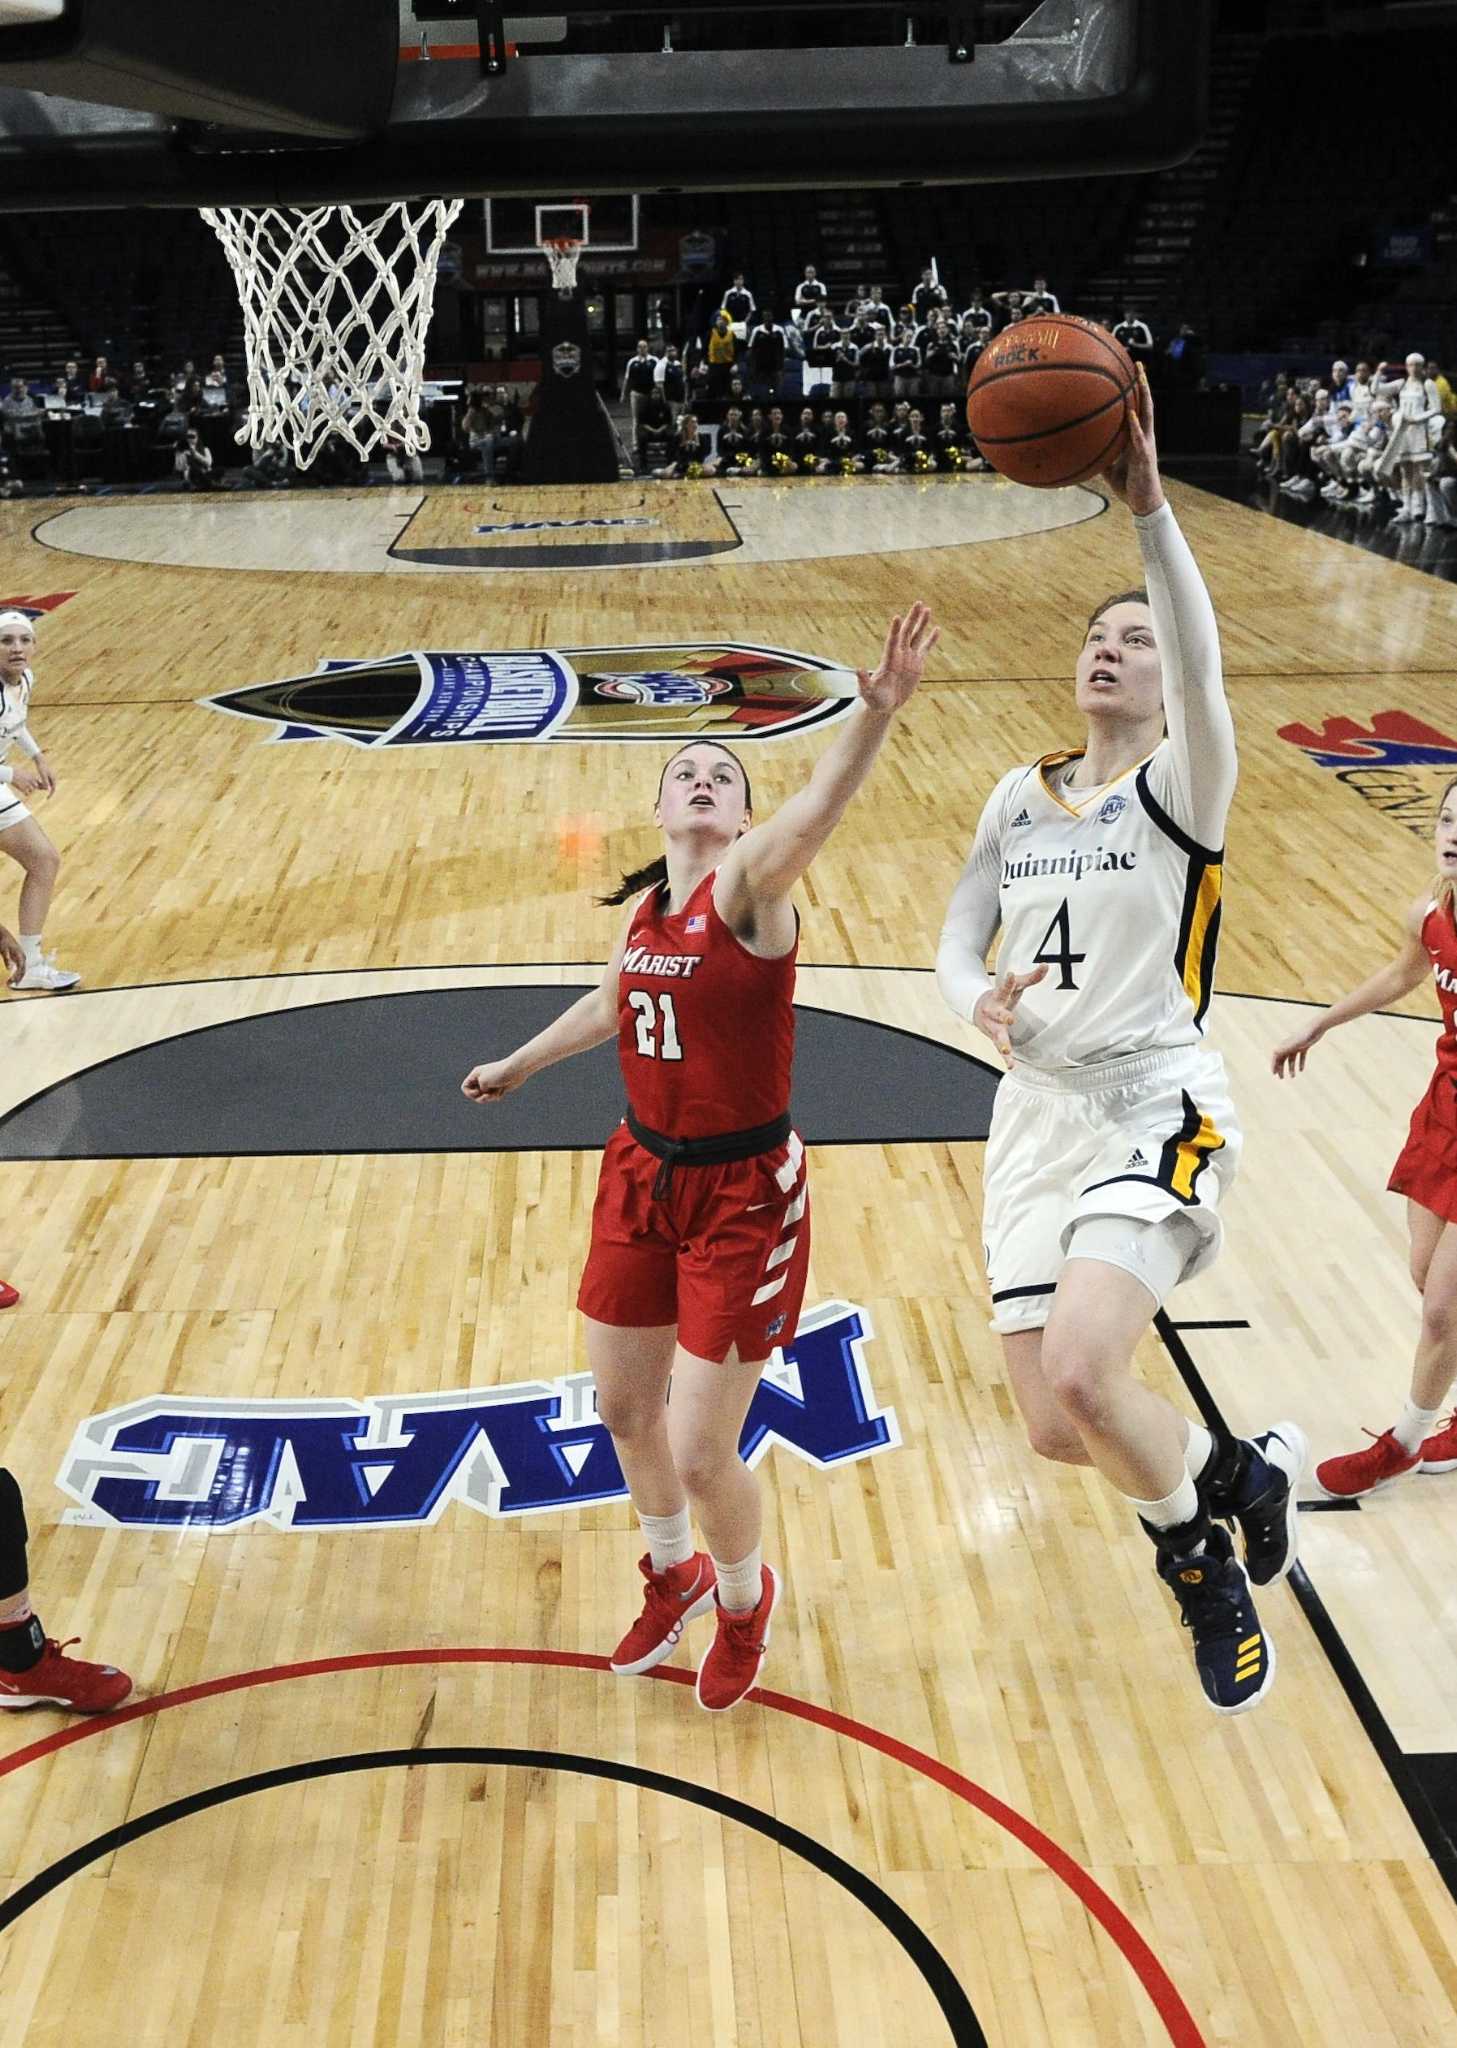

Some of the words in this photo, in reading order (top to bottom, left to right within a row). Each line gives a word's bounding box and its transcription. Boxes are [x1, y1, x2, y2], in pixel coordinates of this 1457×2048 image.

[430, 656, 486, 737] CHAMPIONSHIPS
[458, 655, 556, 737] BASKETBALL
[618, 946, 702, 978] MARIST
[1032, 896, 1087, 991] 4
[627, 989, 683, 1061] 21
